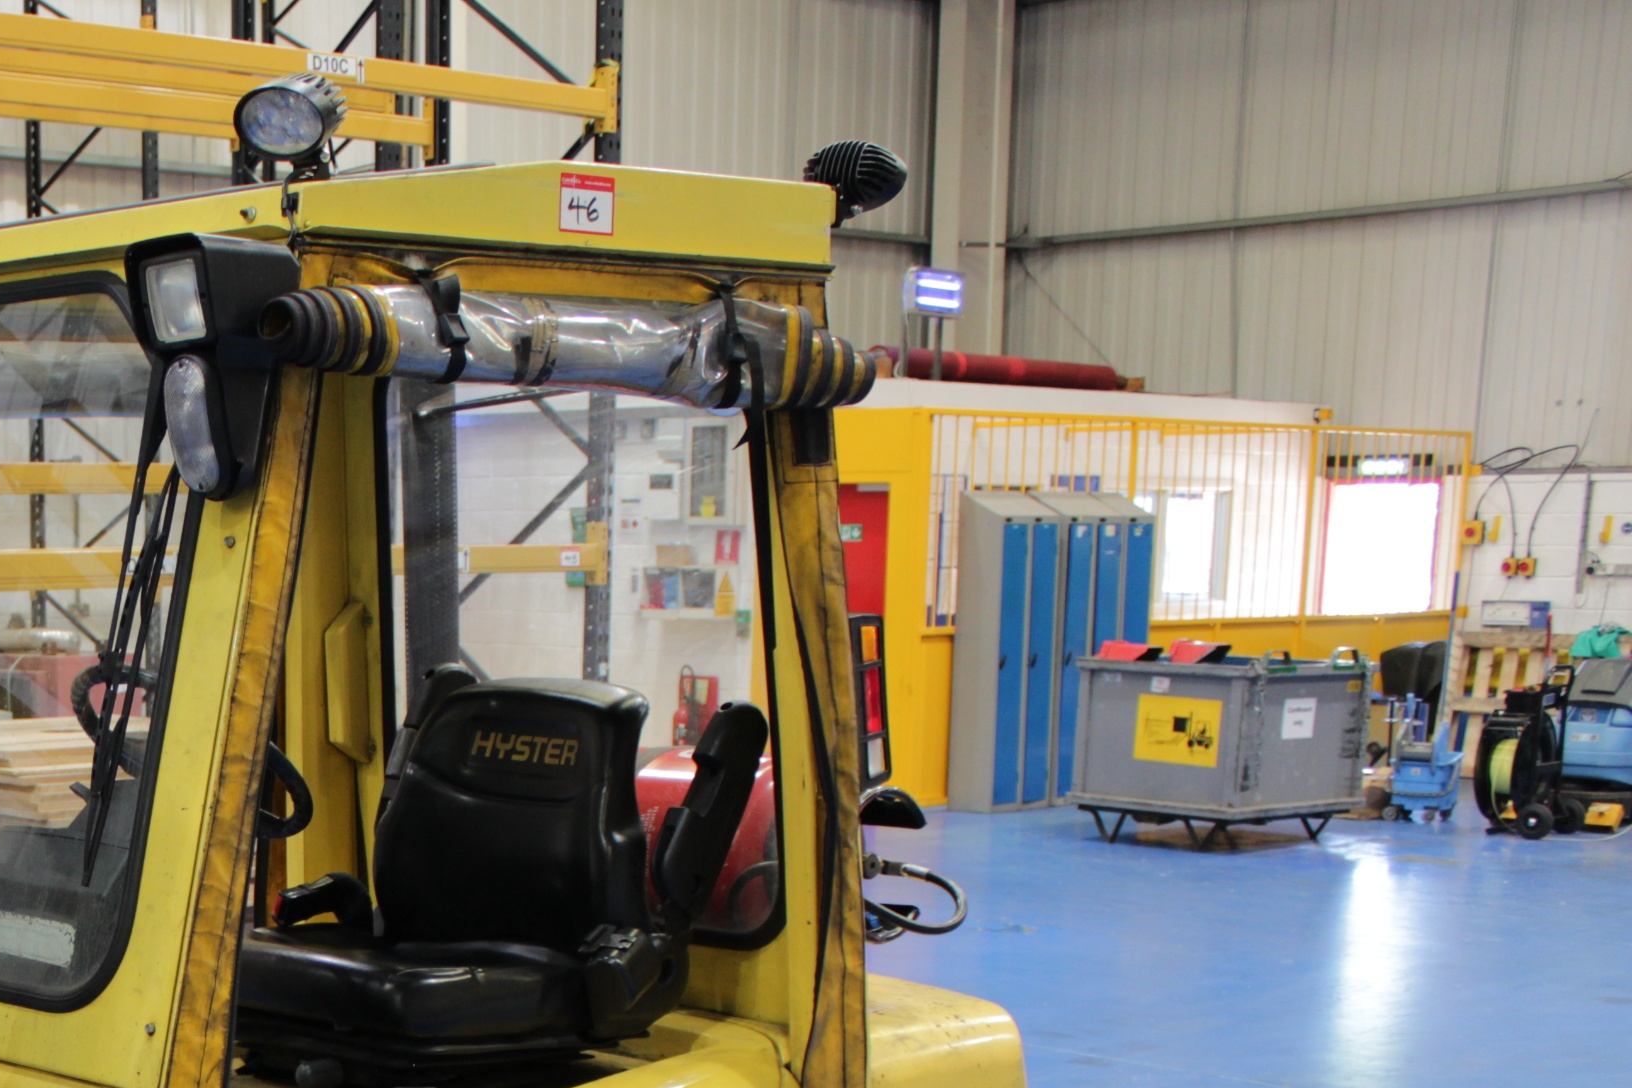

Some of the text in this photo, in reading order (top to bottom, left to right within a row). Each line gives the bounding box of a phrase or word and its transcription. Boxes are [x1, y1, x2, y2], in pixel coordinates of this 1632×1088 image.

[312, 54, 349, 74] D10C
[568, 196, 599, 225] 46
[471, 730, 579, 766] HYSTER
